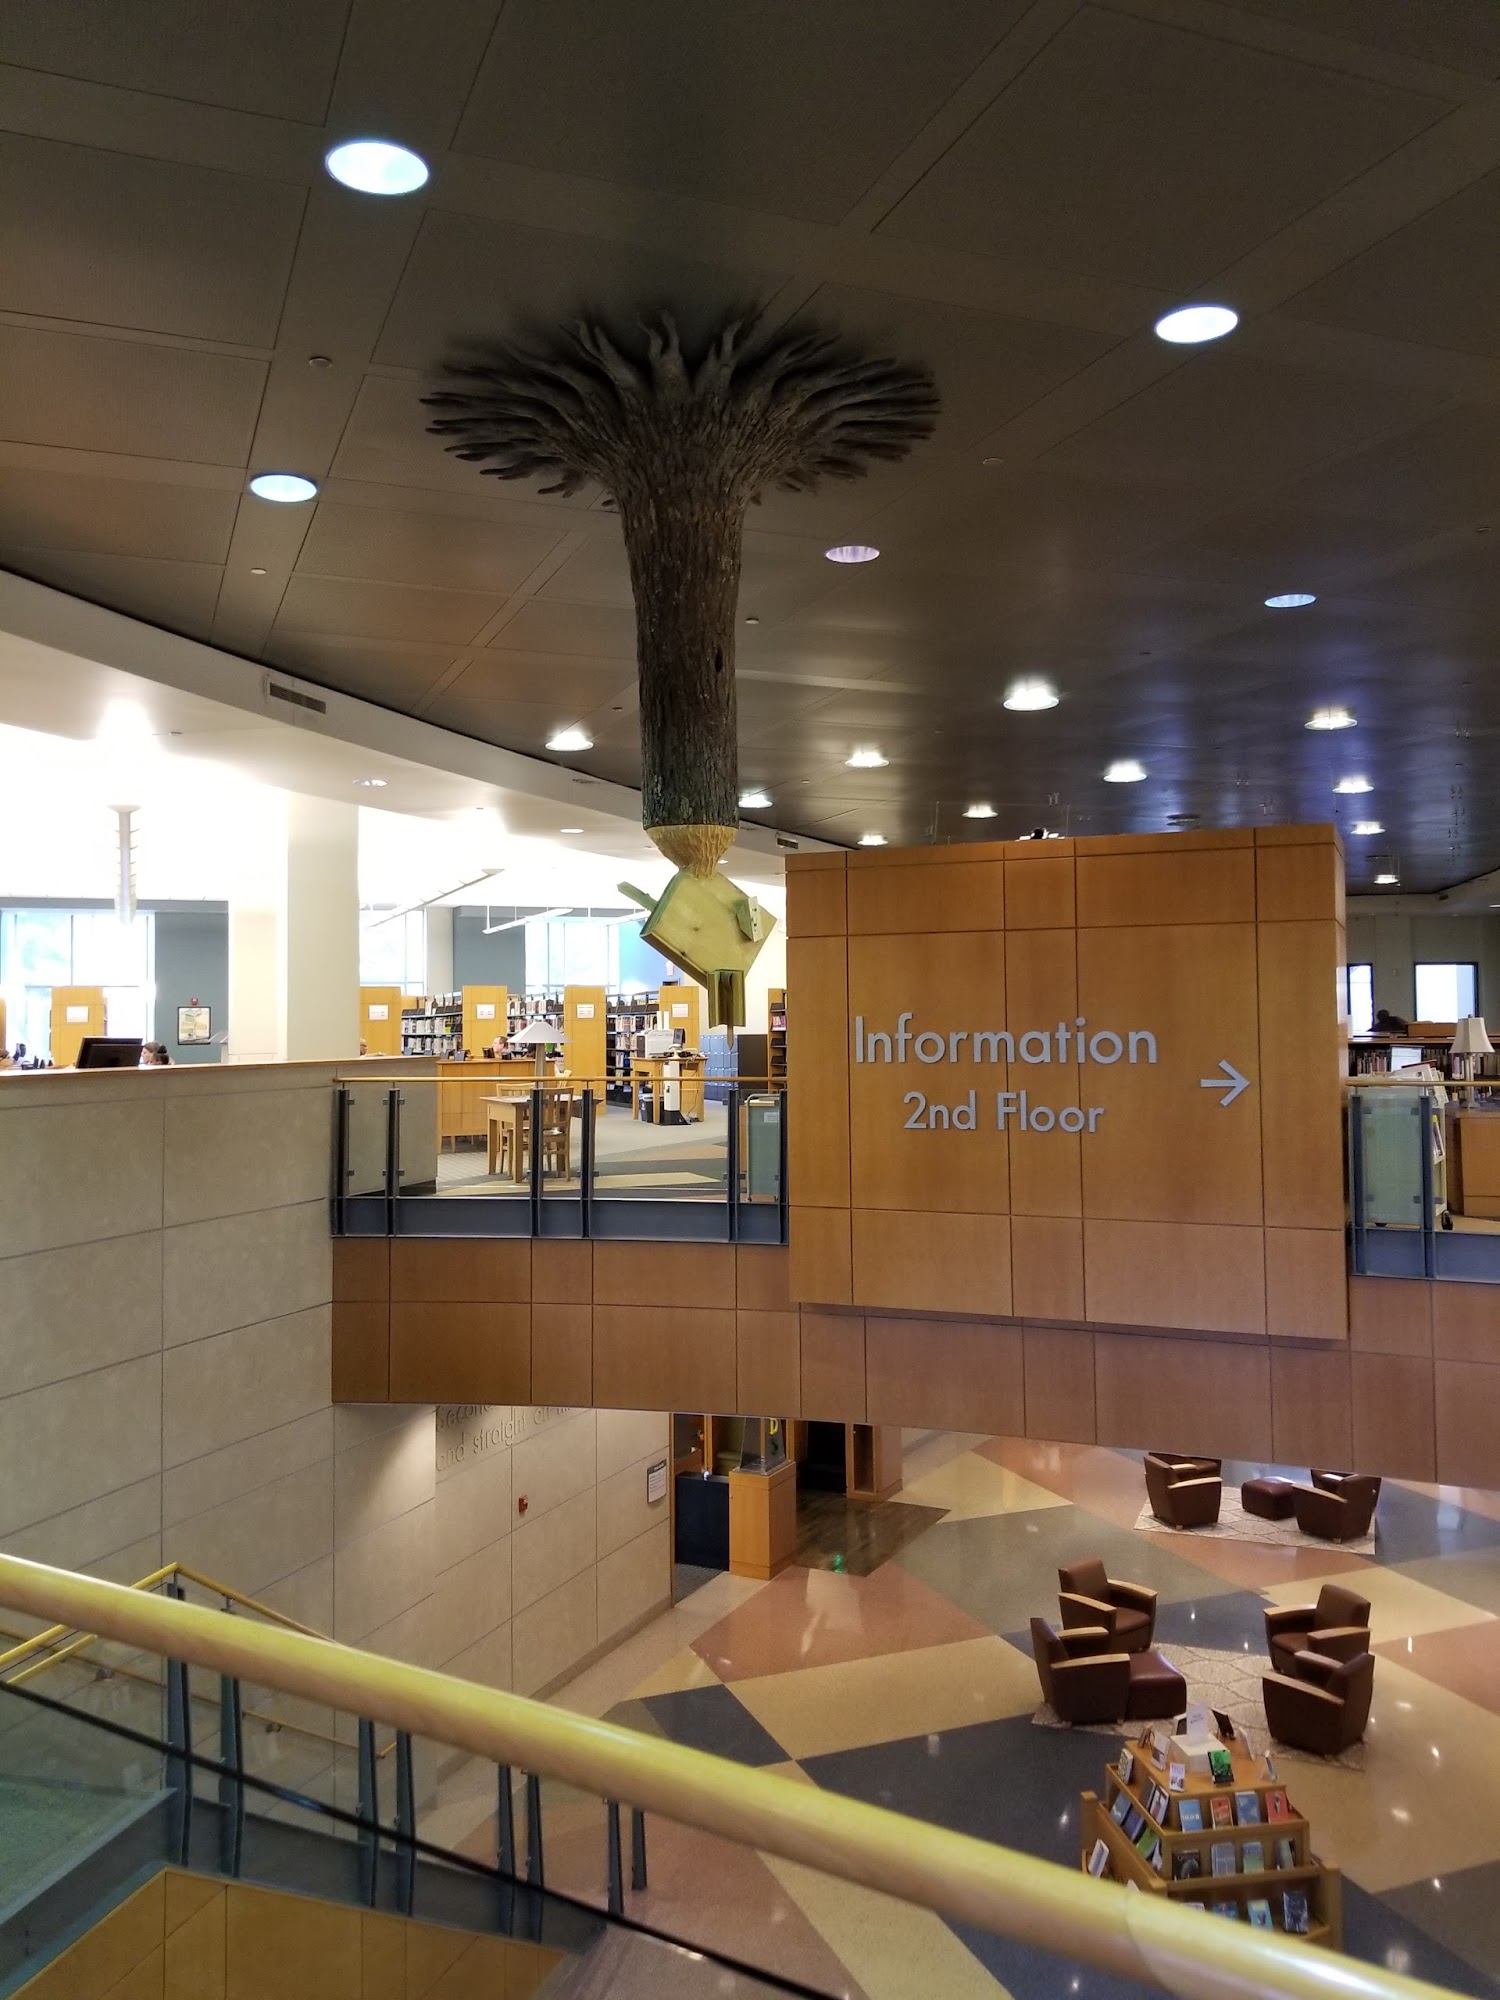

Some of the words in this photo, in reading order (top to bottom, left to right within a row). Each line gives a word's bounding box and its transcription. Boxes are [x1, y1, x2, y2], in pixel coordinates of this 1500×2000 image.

[855, 1012, 1157, 1063] Information
[903, 1089, 976, 1130] 2nd
[996, 1089, 1105, 1133] Floor
[436, 1431, 465, 1471] and
[473, 1407, 525, 1454] straight
